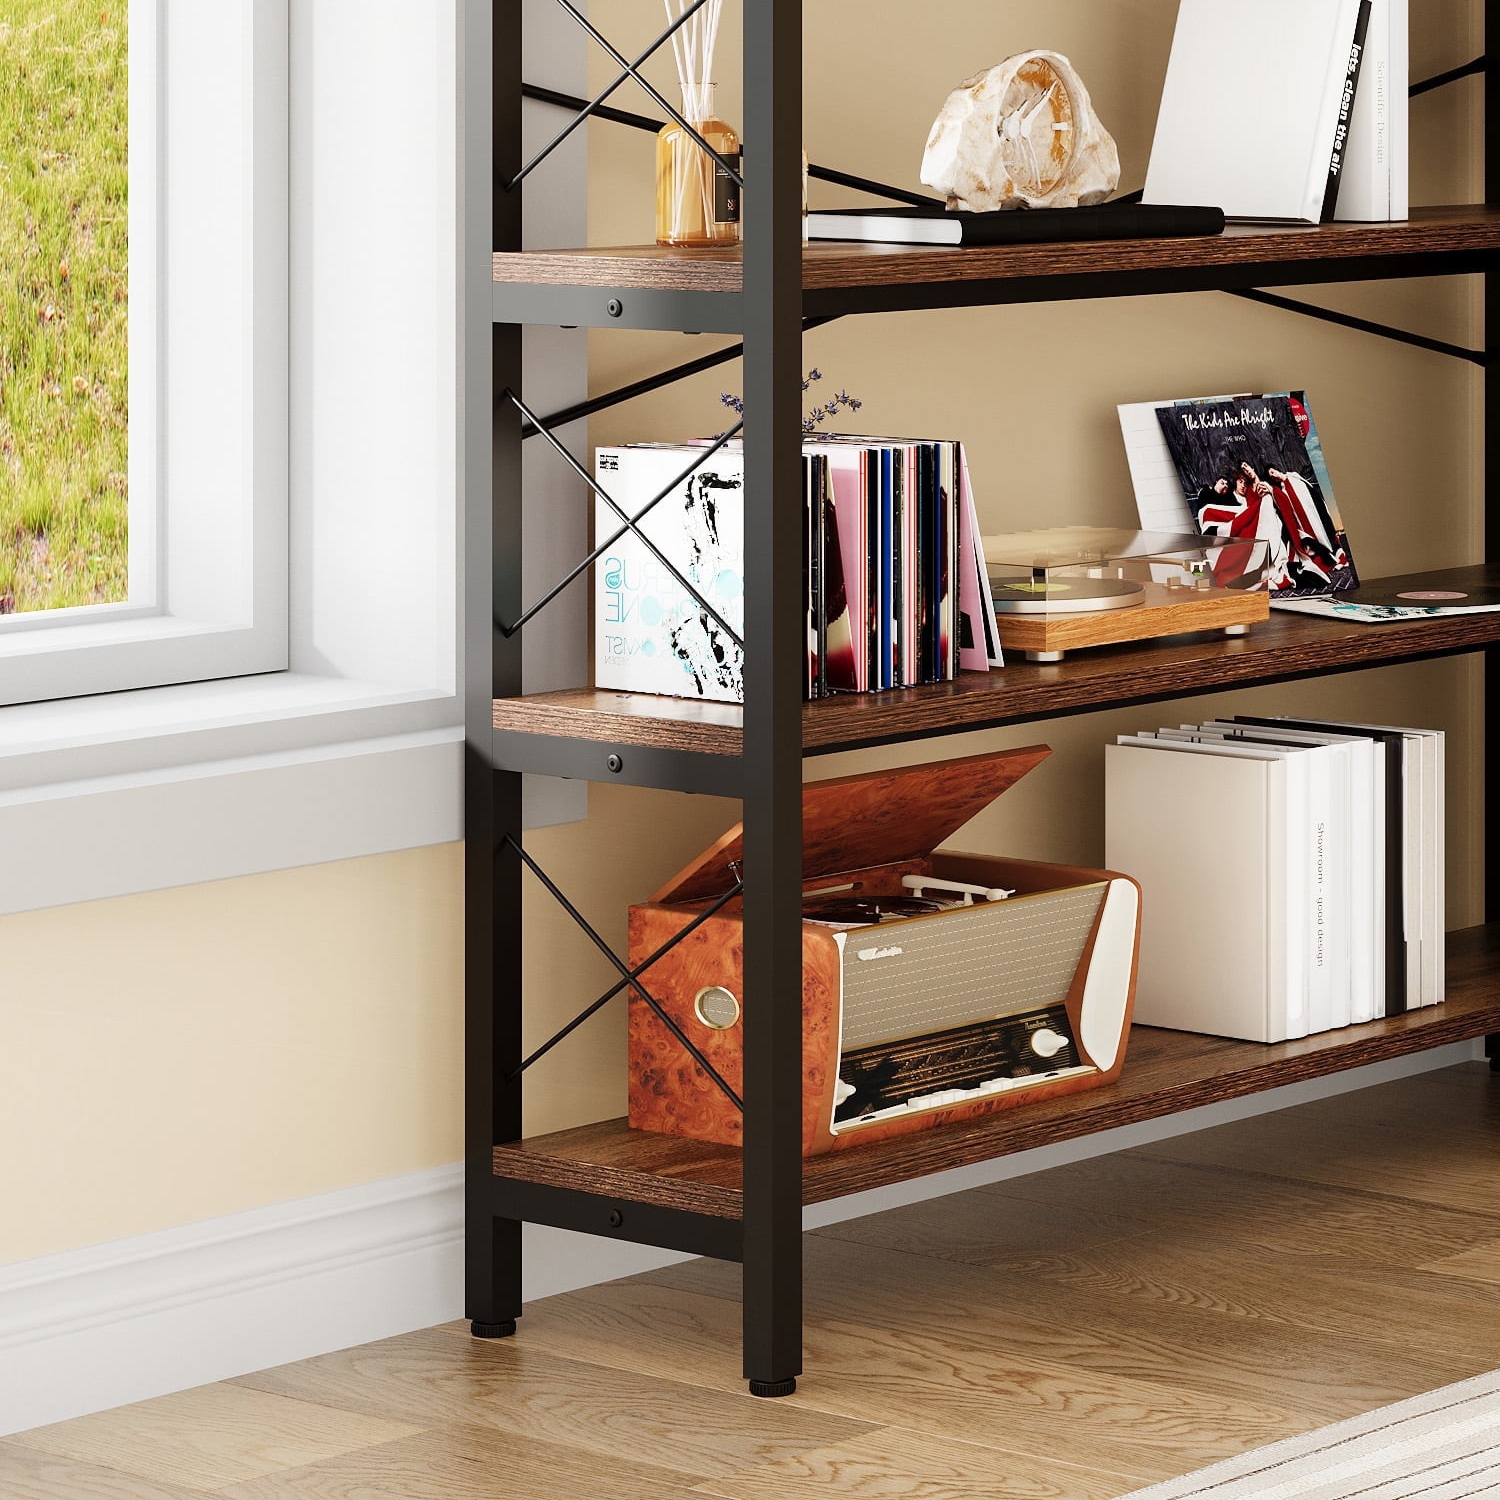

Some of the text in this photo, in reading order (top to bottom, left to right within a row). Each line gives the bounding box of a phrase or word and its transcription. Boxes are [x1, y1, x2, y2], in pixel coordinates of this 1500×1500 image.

[1340, 79, 1354, 121] clean
[1334, 124, 1347, 151] the
[1377, 121, 1385, 164] Design
[1330, 152, 1341, 176] air
[1181, 407, 1275, 430] The Kids Are Alright
[1317, 822, 1325, 884] Showroom
[1316, 897, 1324, 925] good
[1316, 929, 1324, 967] design
